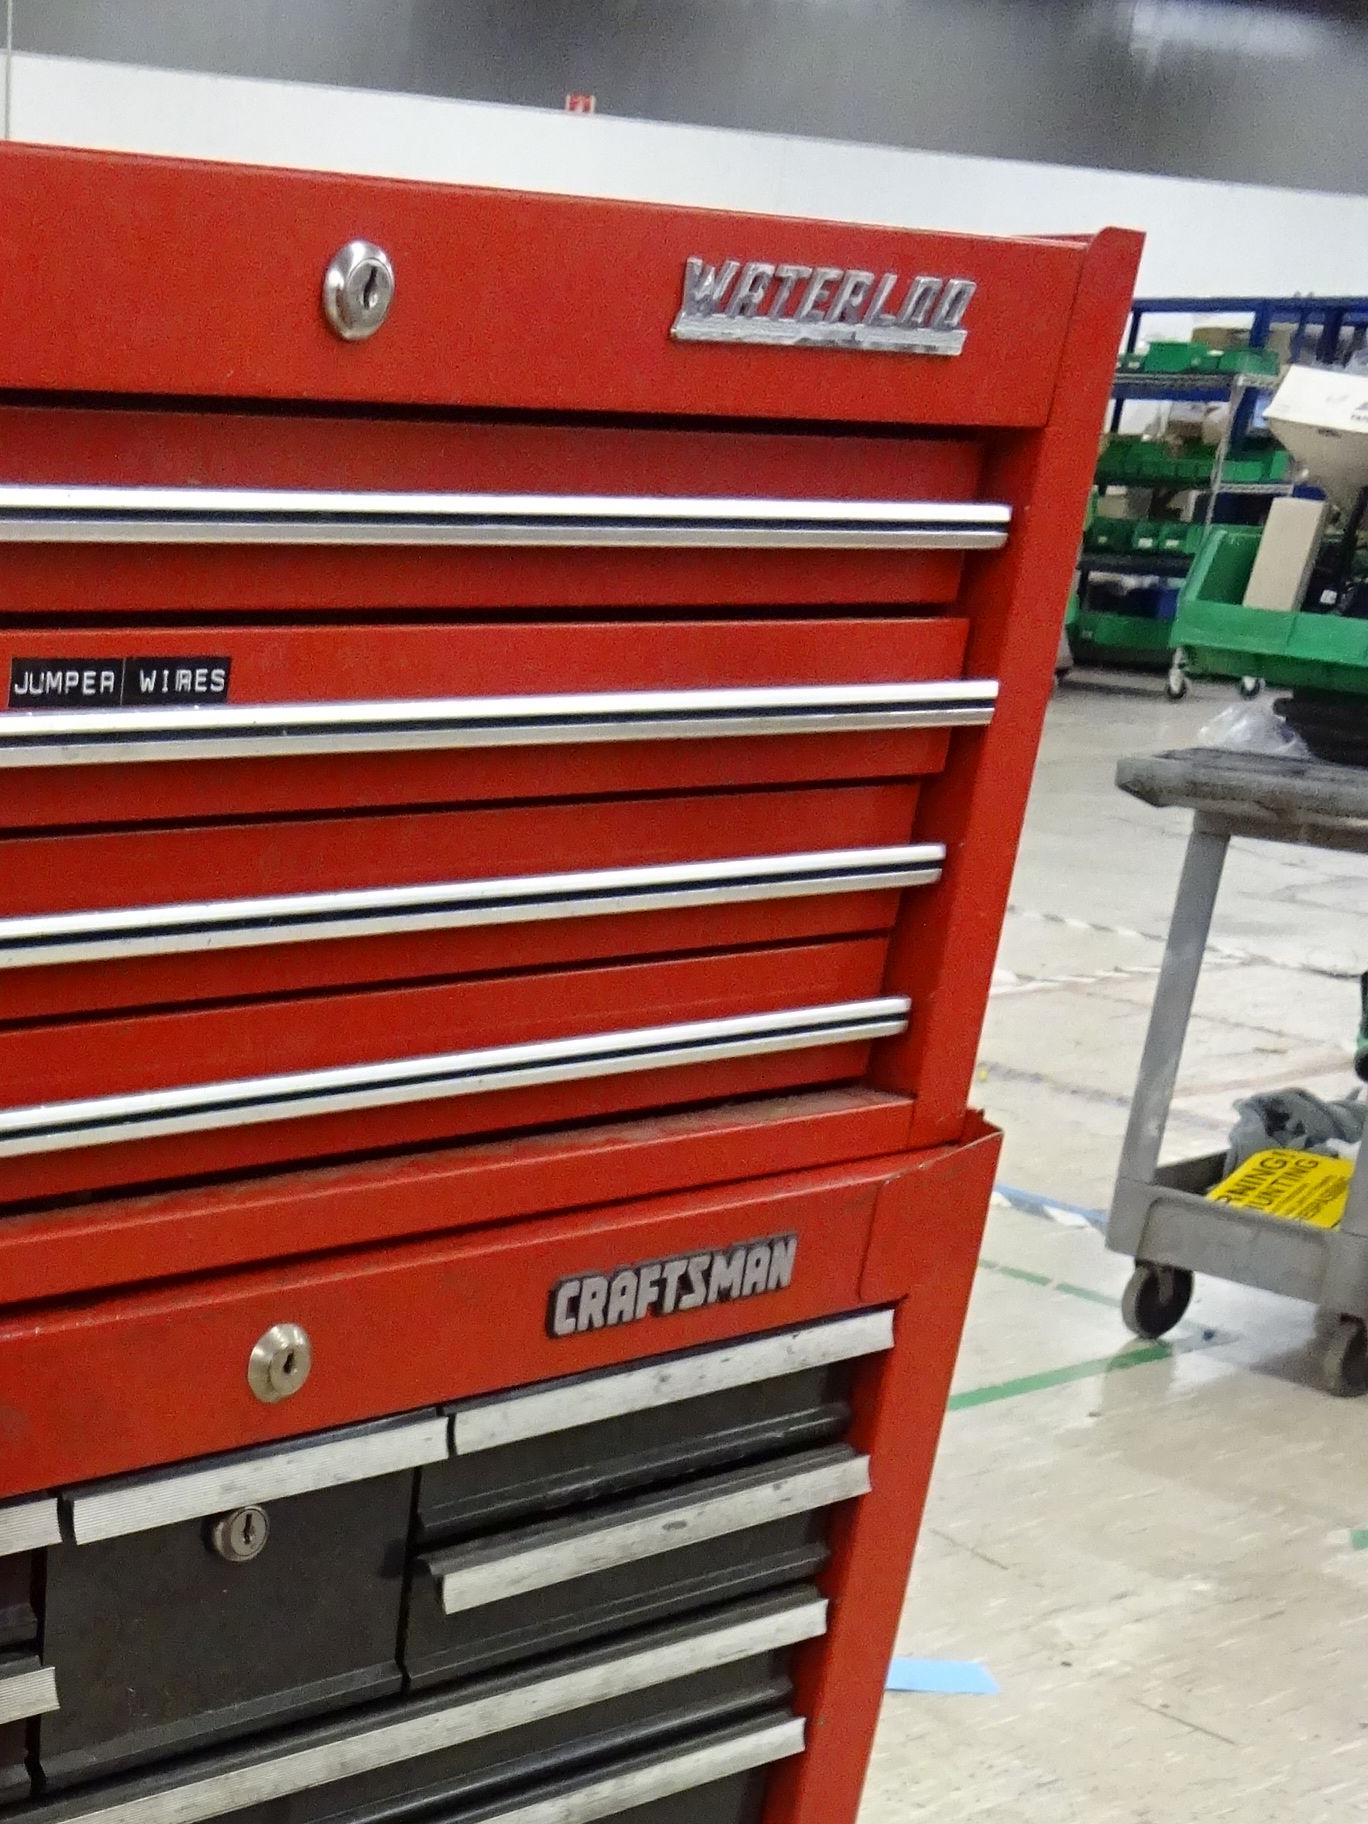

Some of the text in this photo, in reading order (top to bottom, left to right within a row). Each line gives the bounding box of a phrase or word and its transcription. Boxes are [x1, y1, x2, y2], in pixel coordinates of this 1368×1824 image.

[680, 257, 978, 331] WATERLOO
[13, 668, 226, 695] JUMPER WIRES
[547, 1234, 798, 1338] CRAFTSMAN
